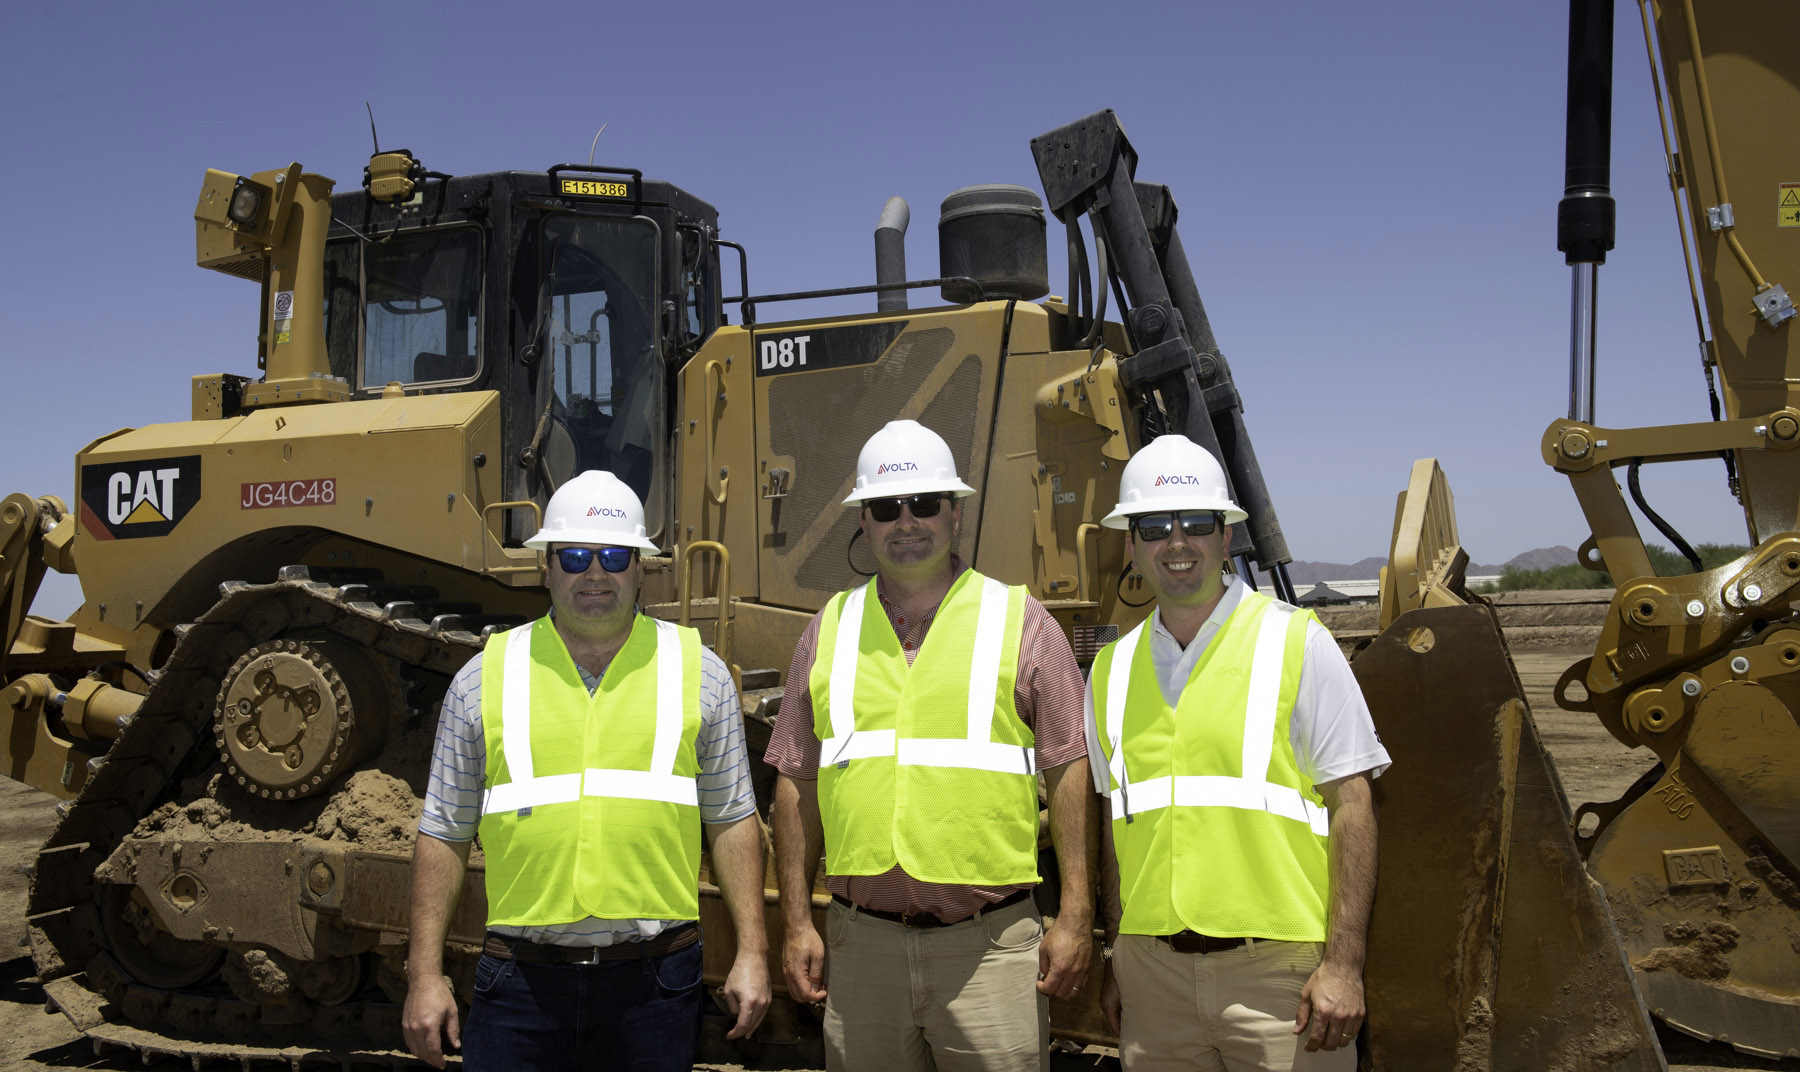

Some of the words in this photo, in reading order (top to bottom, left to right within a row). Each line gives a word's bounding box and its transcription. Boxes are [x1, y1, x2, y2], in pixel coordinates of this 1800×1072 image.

[563, 181, 626, 196] E151386
[761, 336, 810, 370] D8T
[107, 467, 180, 525] CAT
[243, 479, 335, 507] JG4C48
[1669, 852, 1718, 882] CAT
